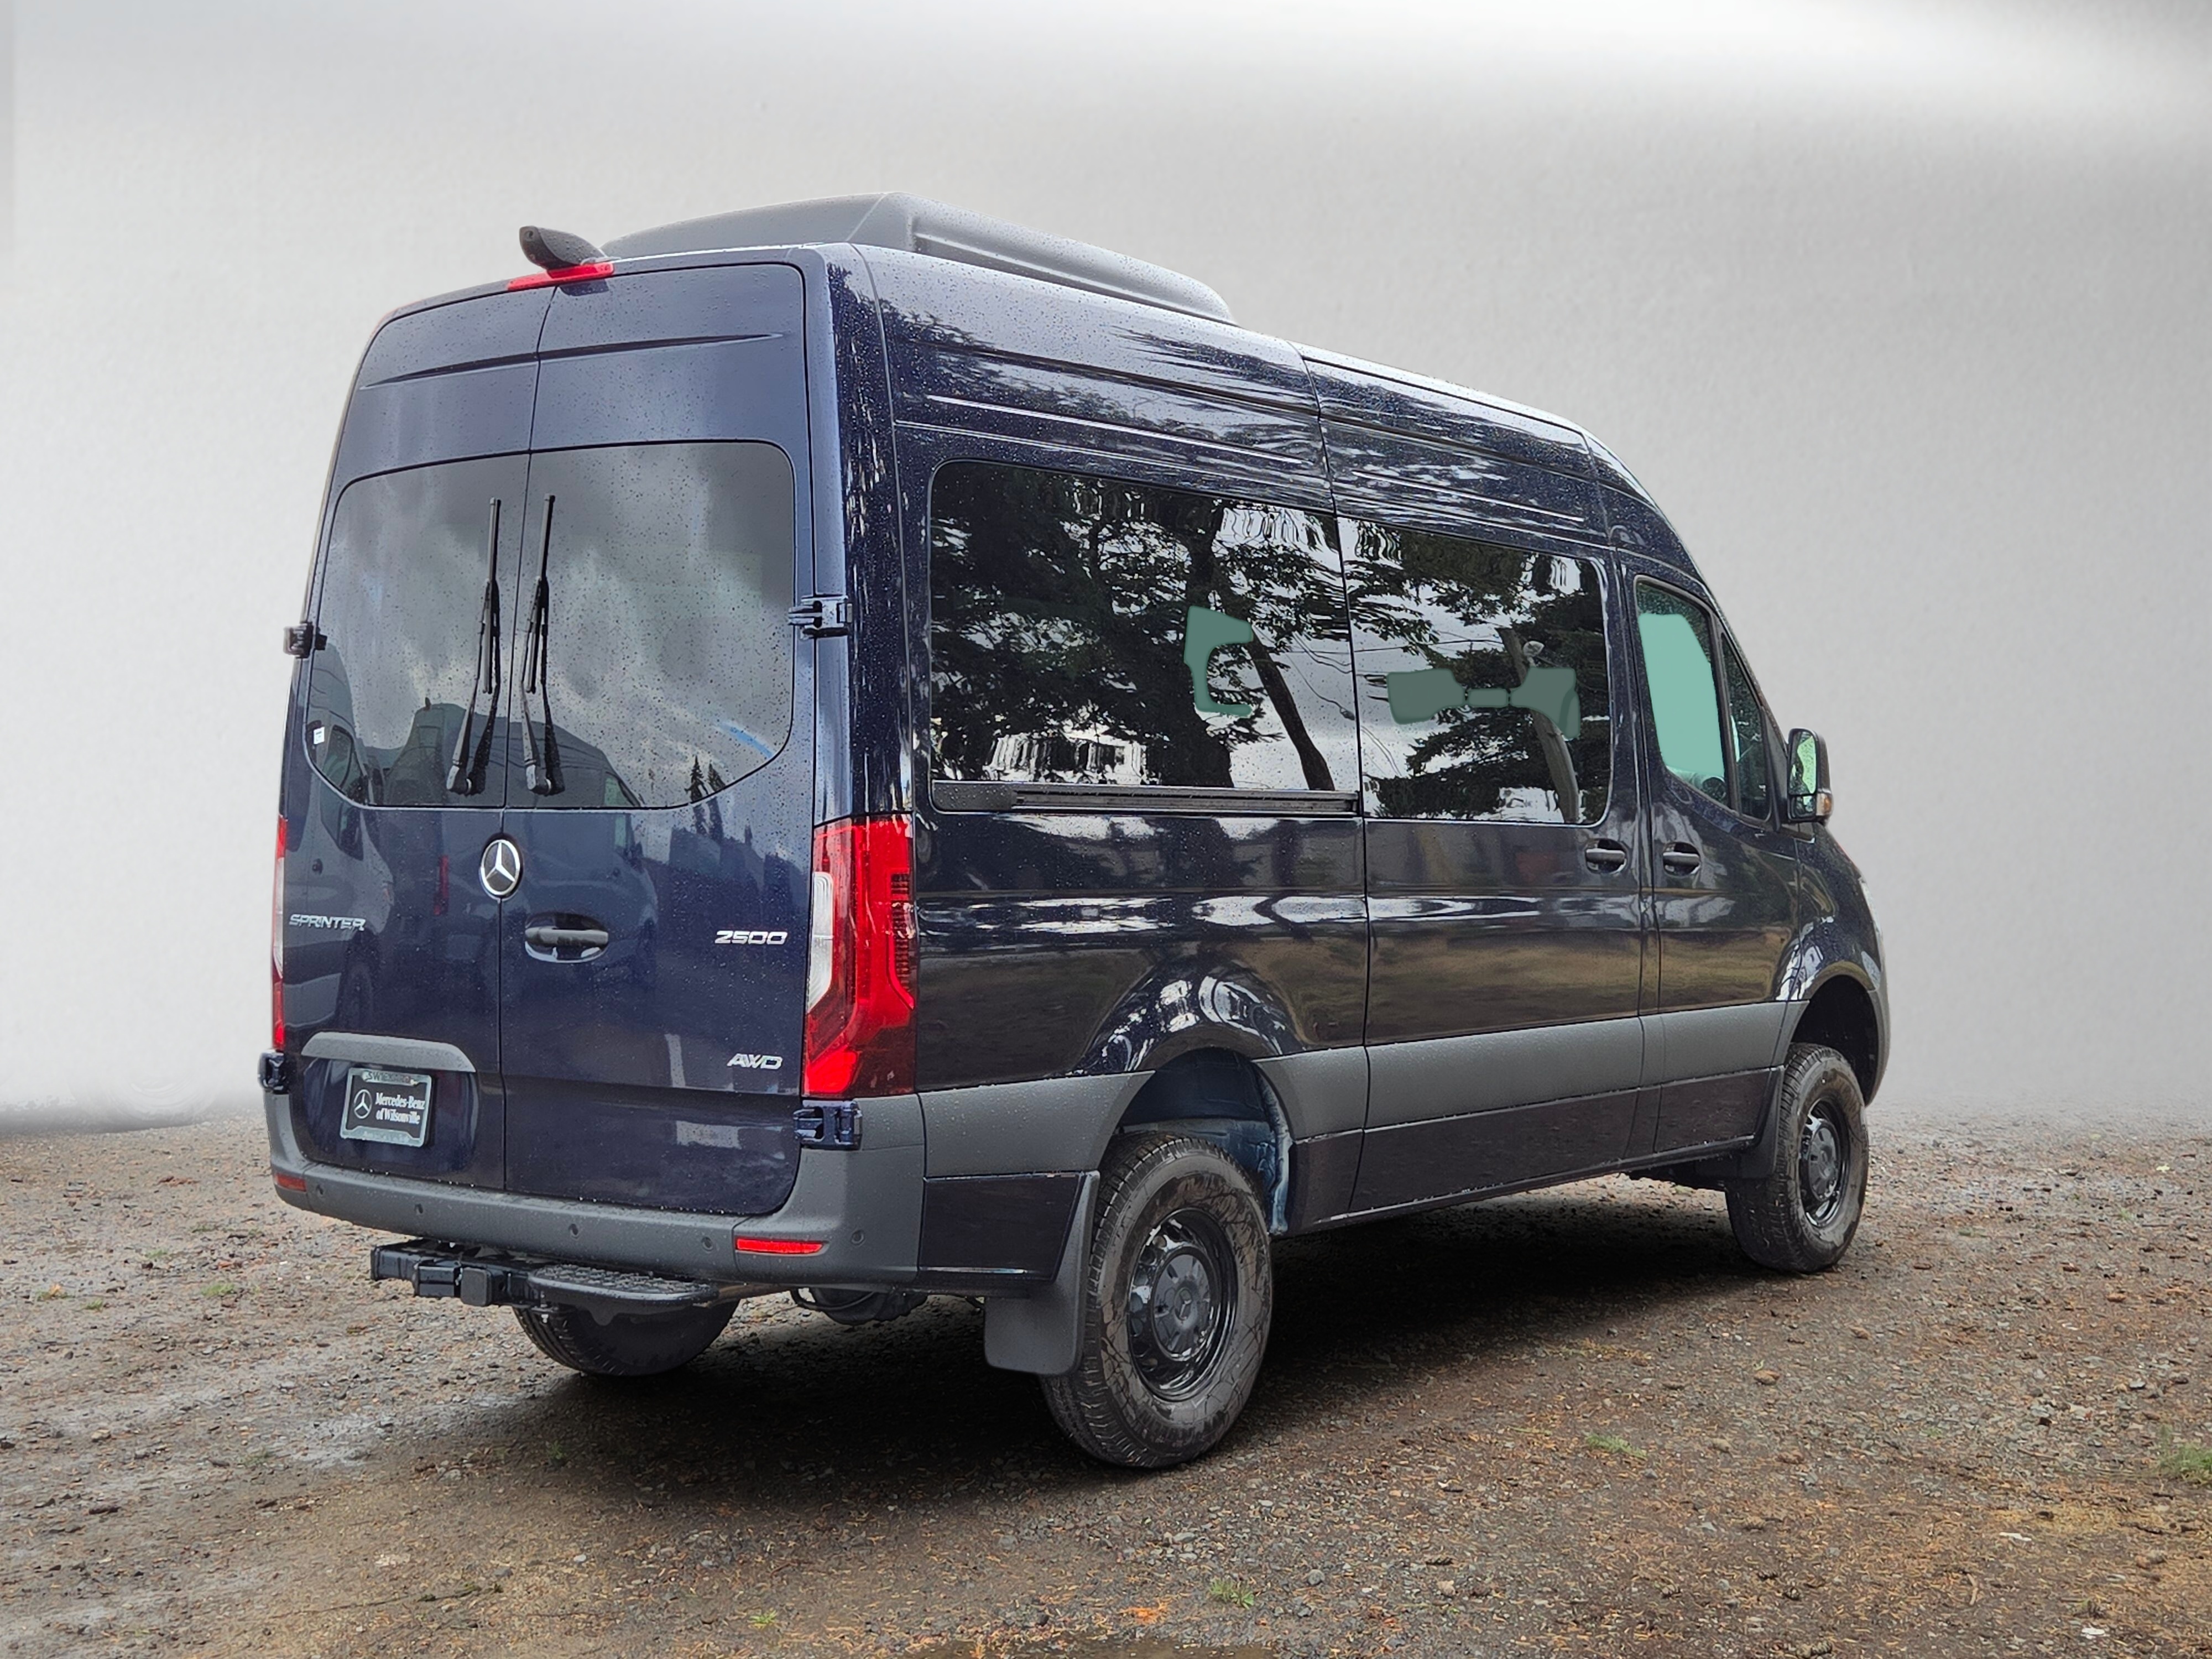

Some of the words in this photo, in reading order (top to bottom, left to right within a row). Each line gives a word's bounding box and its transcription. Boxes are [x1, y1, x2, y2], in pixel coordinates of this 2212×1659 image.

[289, 914, 366, 931] SPRINTER
[715, 931, 787, 945] 2500
[727, 1053, 782, 1070] AWD
[375, 1092, 425, 1109] Mercedes-Benz
[376, 1108, 385, 1120] of
[384, 1109, 420, 1124] Wilsonville
